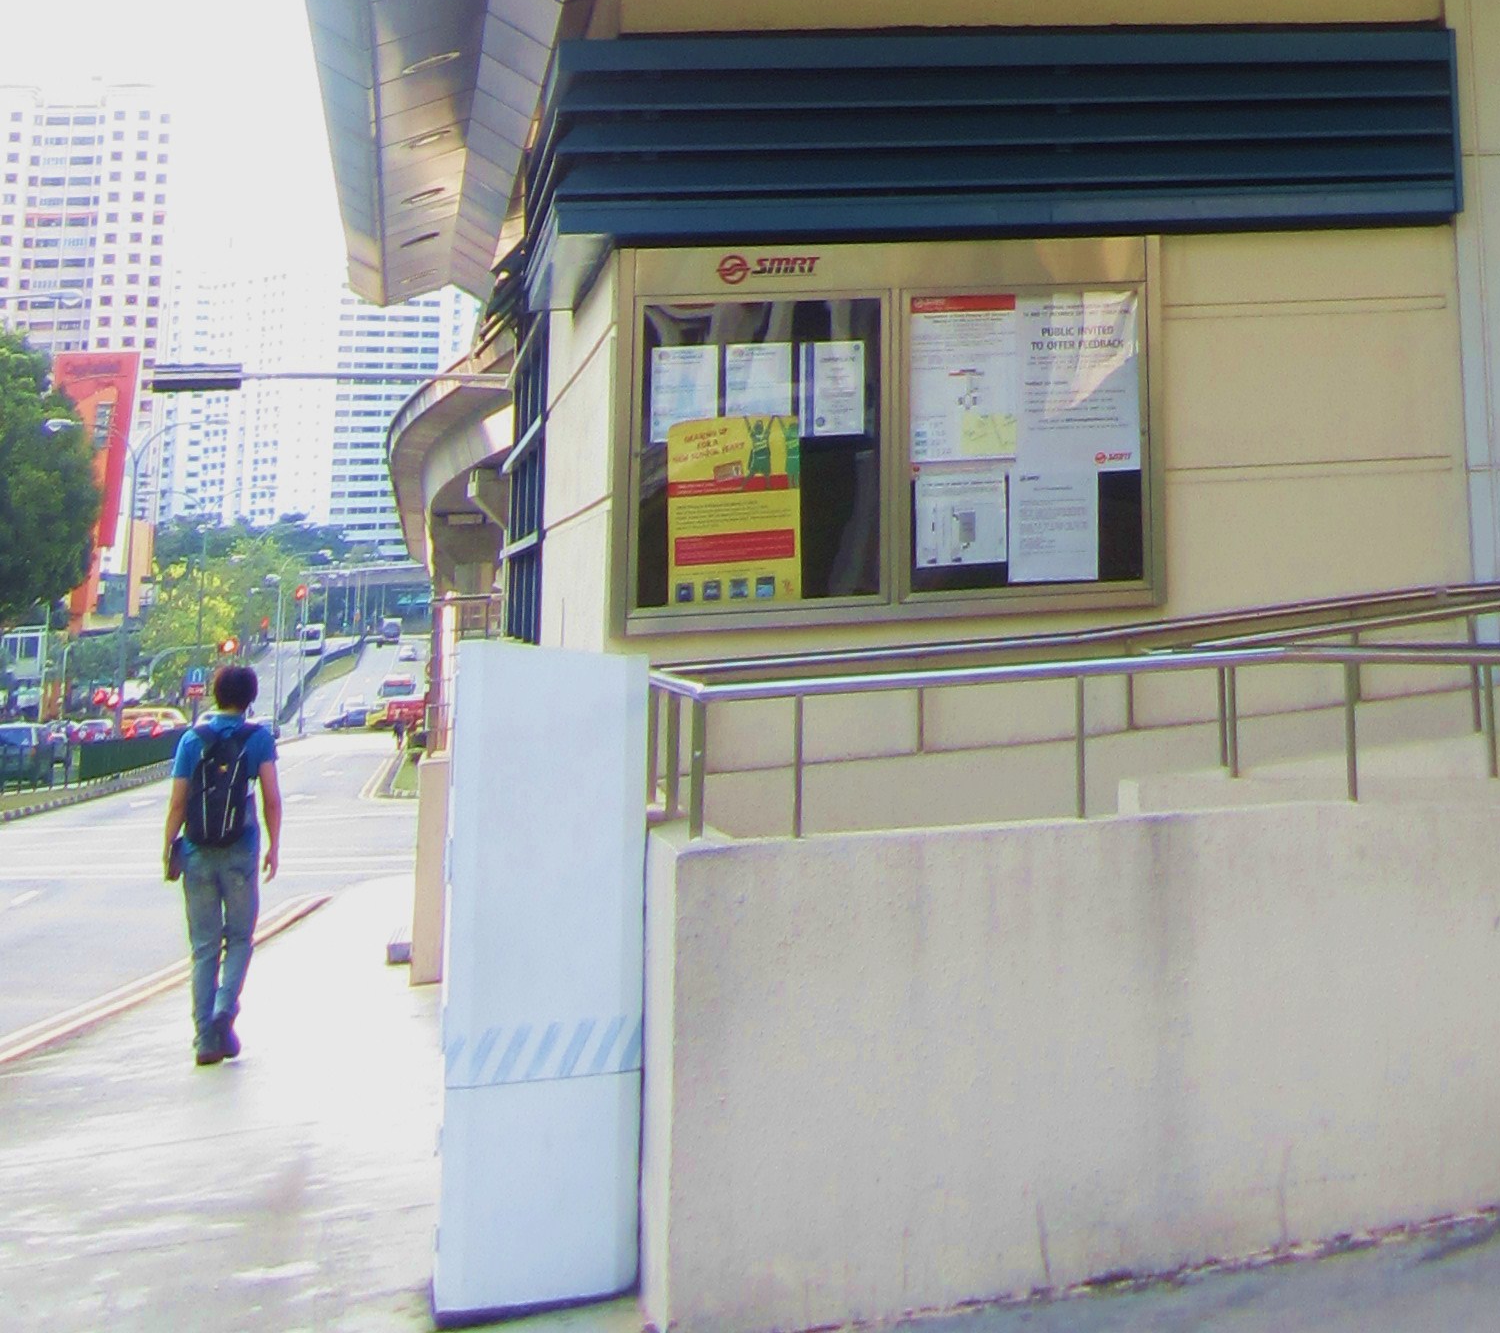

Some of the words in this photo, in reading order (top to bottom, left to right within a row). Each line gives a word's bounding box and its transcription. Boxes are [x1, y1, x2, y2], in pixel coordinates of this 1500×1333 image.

[751, 256, 821, 275] SMRT
[1041, 326, 1074, 337] PUBLIC
[1077, 325, 1114, 336] INVITED
[1031, 341, 1044, 351] TO
[1046, 340, 1075, 350] OFFER
